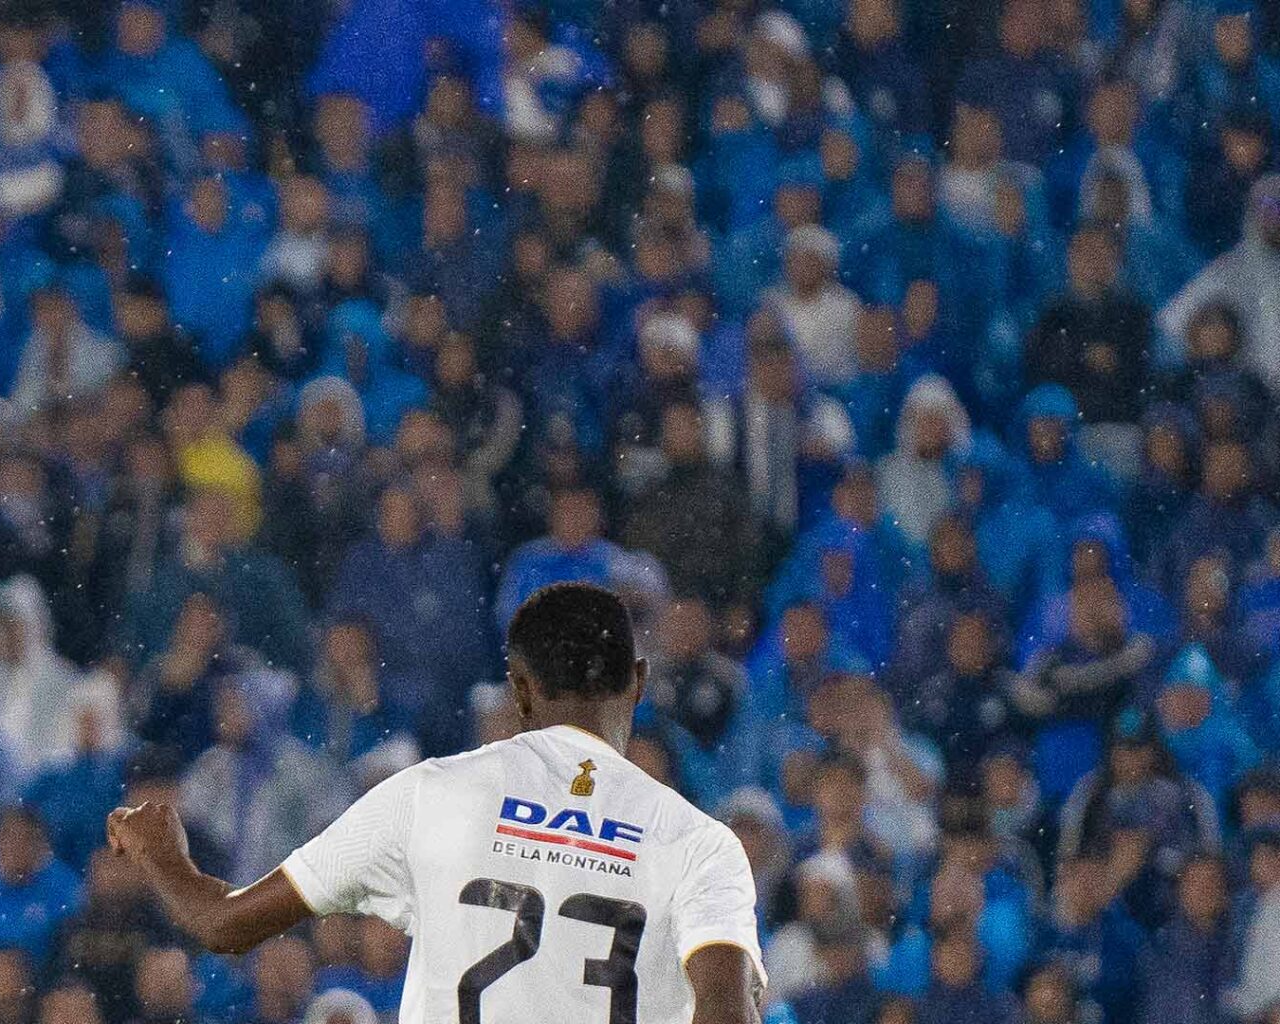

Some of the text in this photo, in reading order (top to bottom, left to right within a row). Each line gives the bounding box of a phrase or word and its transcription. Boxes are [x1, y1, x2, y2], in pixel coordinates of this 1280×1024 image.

[499, 796, 644, 843] DAF
[493, 841, 515, 856] DE
[521, 847, 541, 861] LA
